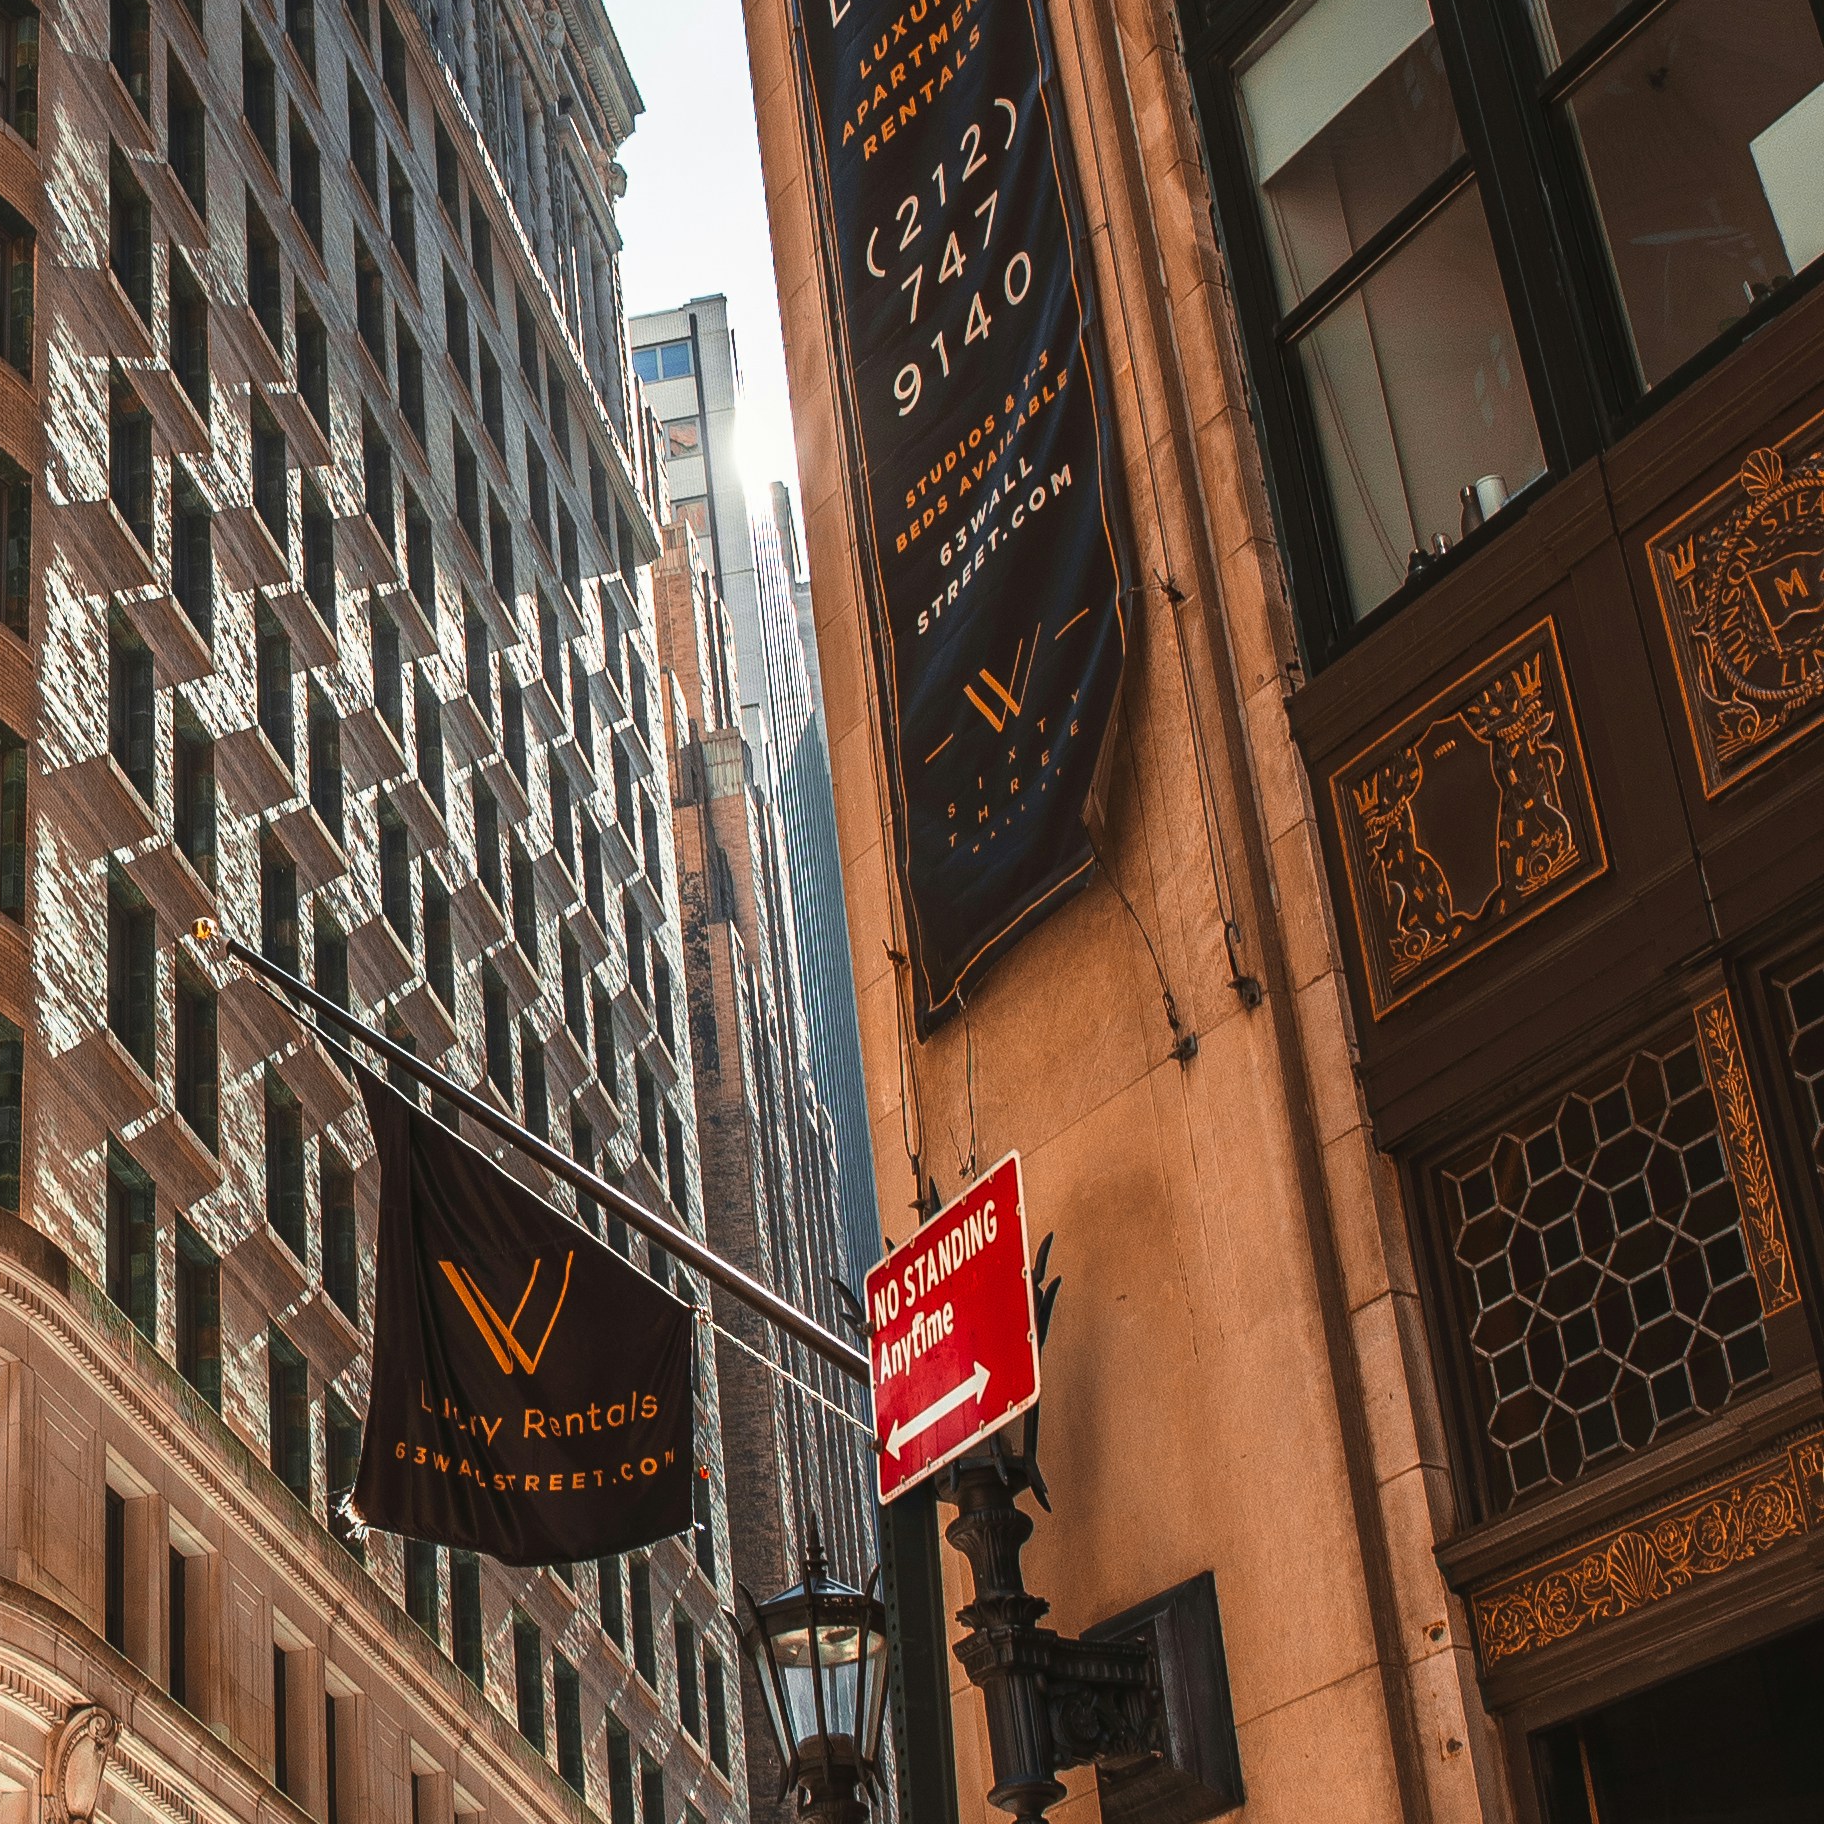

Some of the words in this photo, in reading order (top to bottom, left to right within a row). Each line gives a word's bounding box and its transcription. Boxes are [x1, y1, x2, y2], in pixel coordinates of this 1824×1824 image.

[863, 30, 982, 161] RENTALS
[866, 98, 1017, 277] (212)
[901, 190, 998, 325] 747
[894, 250, 1031, 417] 9140
[896, 494, 949, 554] BEDS
[958, 370, 1069, 499] AVAILABLE
[905, 414, 997, 509] STUDIOS
[1004, 395, 1016, 415] &
[1023, 350, 1050, 389] 1-3
[917, 464, 1073, 636] STREET.COM
[939, 457, 1033, 566] 63WALL
[1719, 536, 1759, 676] MUNSON
[947, 687, 1080, 819] SIXTY
[948, 719, 1079, 848] THREE
[874, 1278, 900, 1333] NO
[903, 1199, 998, 1308] STANDING
[880, 1301, 954, 1385] Anytime
[523, 1390, 658, 1439] Rentals
